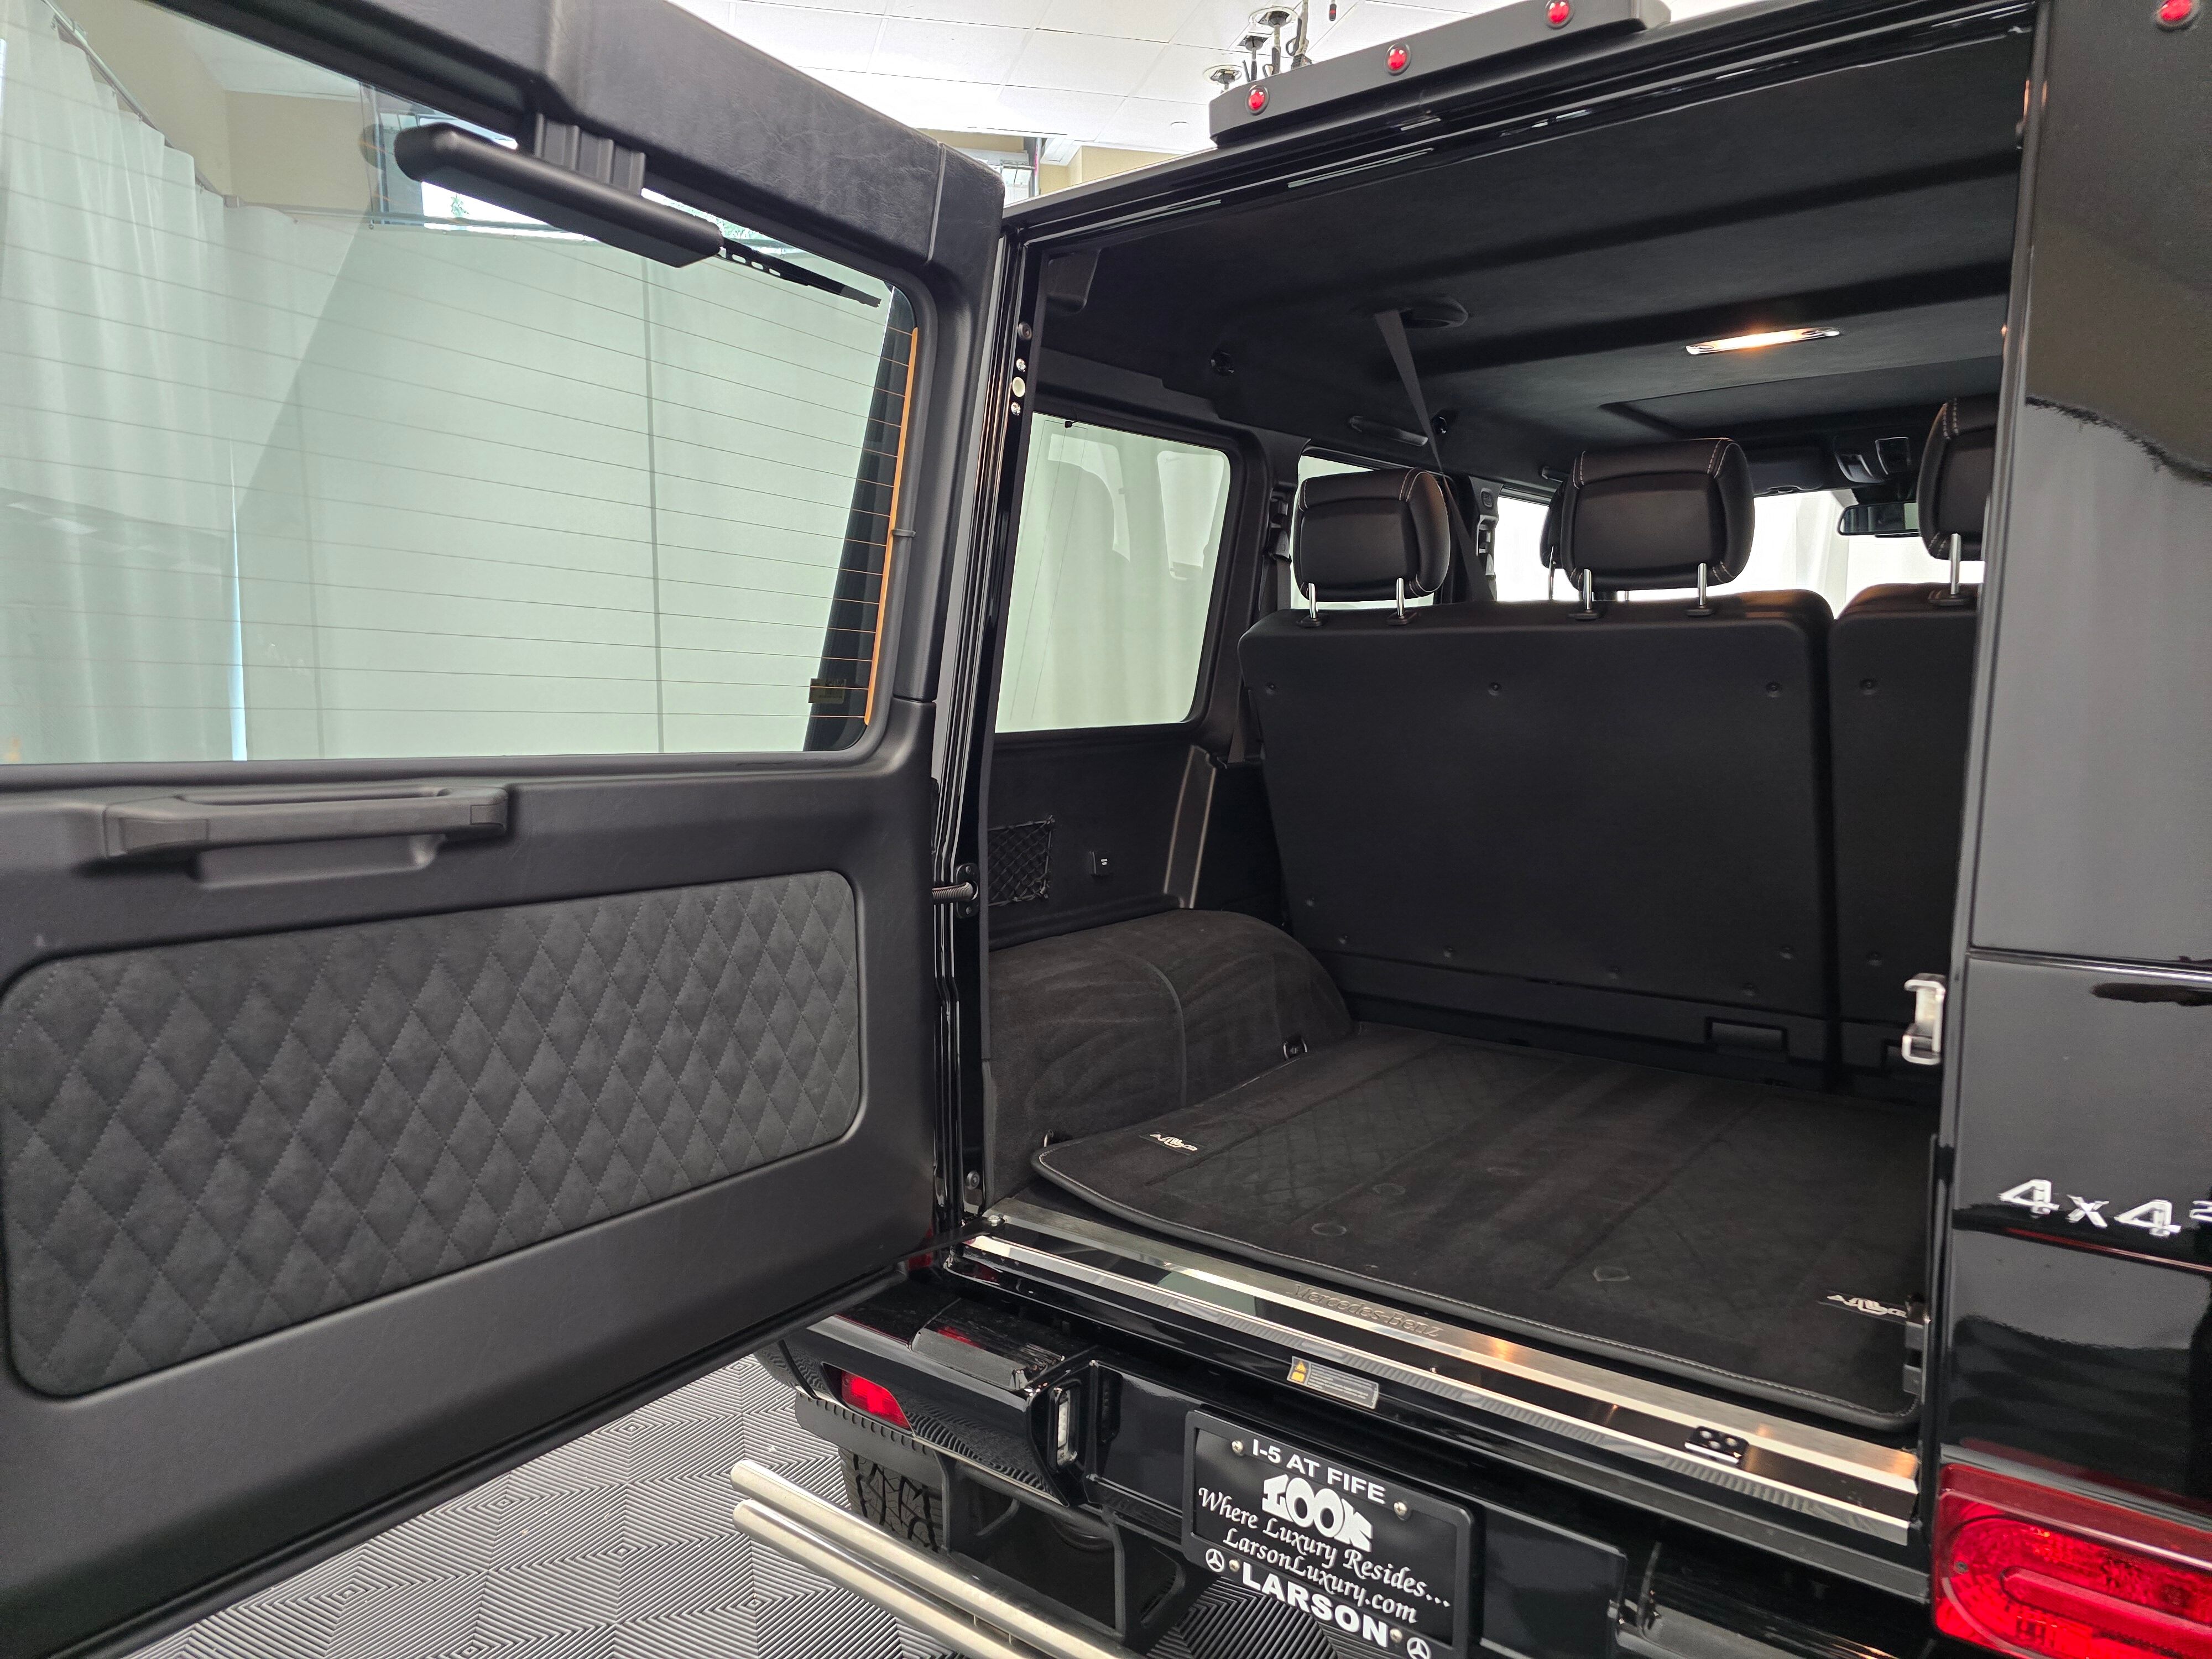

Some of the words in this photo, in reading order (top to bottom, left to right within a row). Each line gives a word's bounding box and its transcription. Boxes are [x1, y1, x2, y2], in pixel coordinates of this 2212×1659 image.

[1286, 1284, 1444, 1337] Mercedes-Benz
[1253, 1439, 1281, 1463] I-5
[1286, 1454, 1321, 1478] AT
[1327, 1467, 1386, 1505] FIFE
[1198, 1488, 1258, 1528] Where
[1262, 1518, 1337, 1569] Luxury
[1343, 1549, 1451, 1607] Resides...
[1223, 1528, 1417, 1624] LarsonLuxury.com
[1243, 1562, 1389, 1647] LARSON
